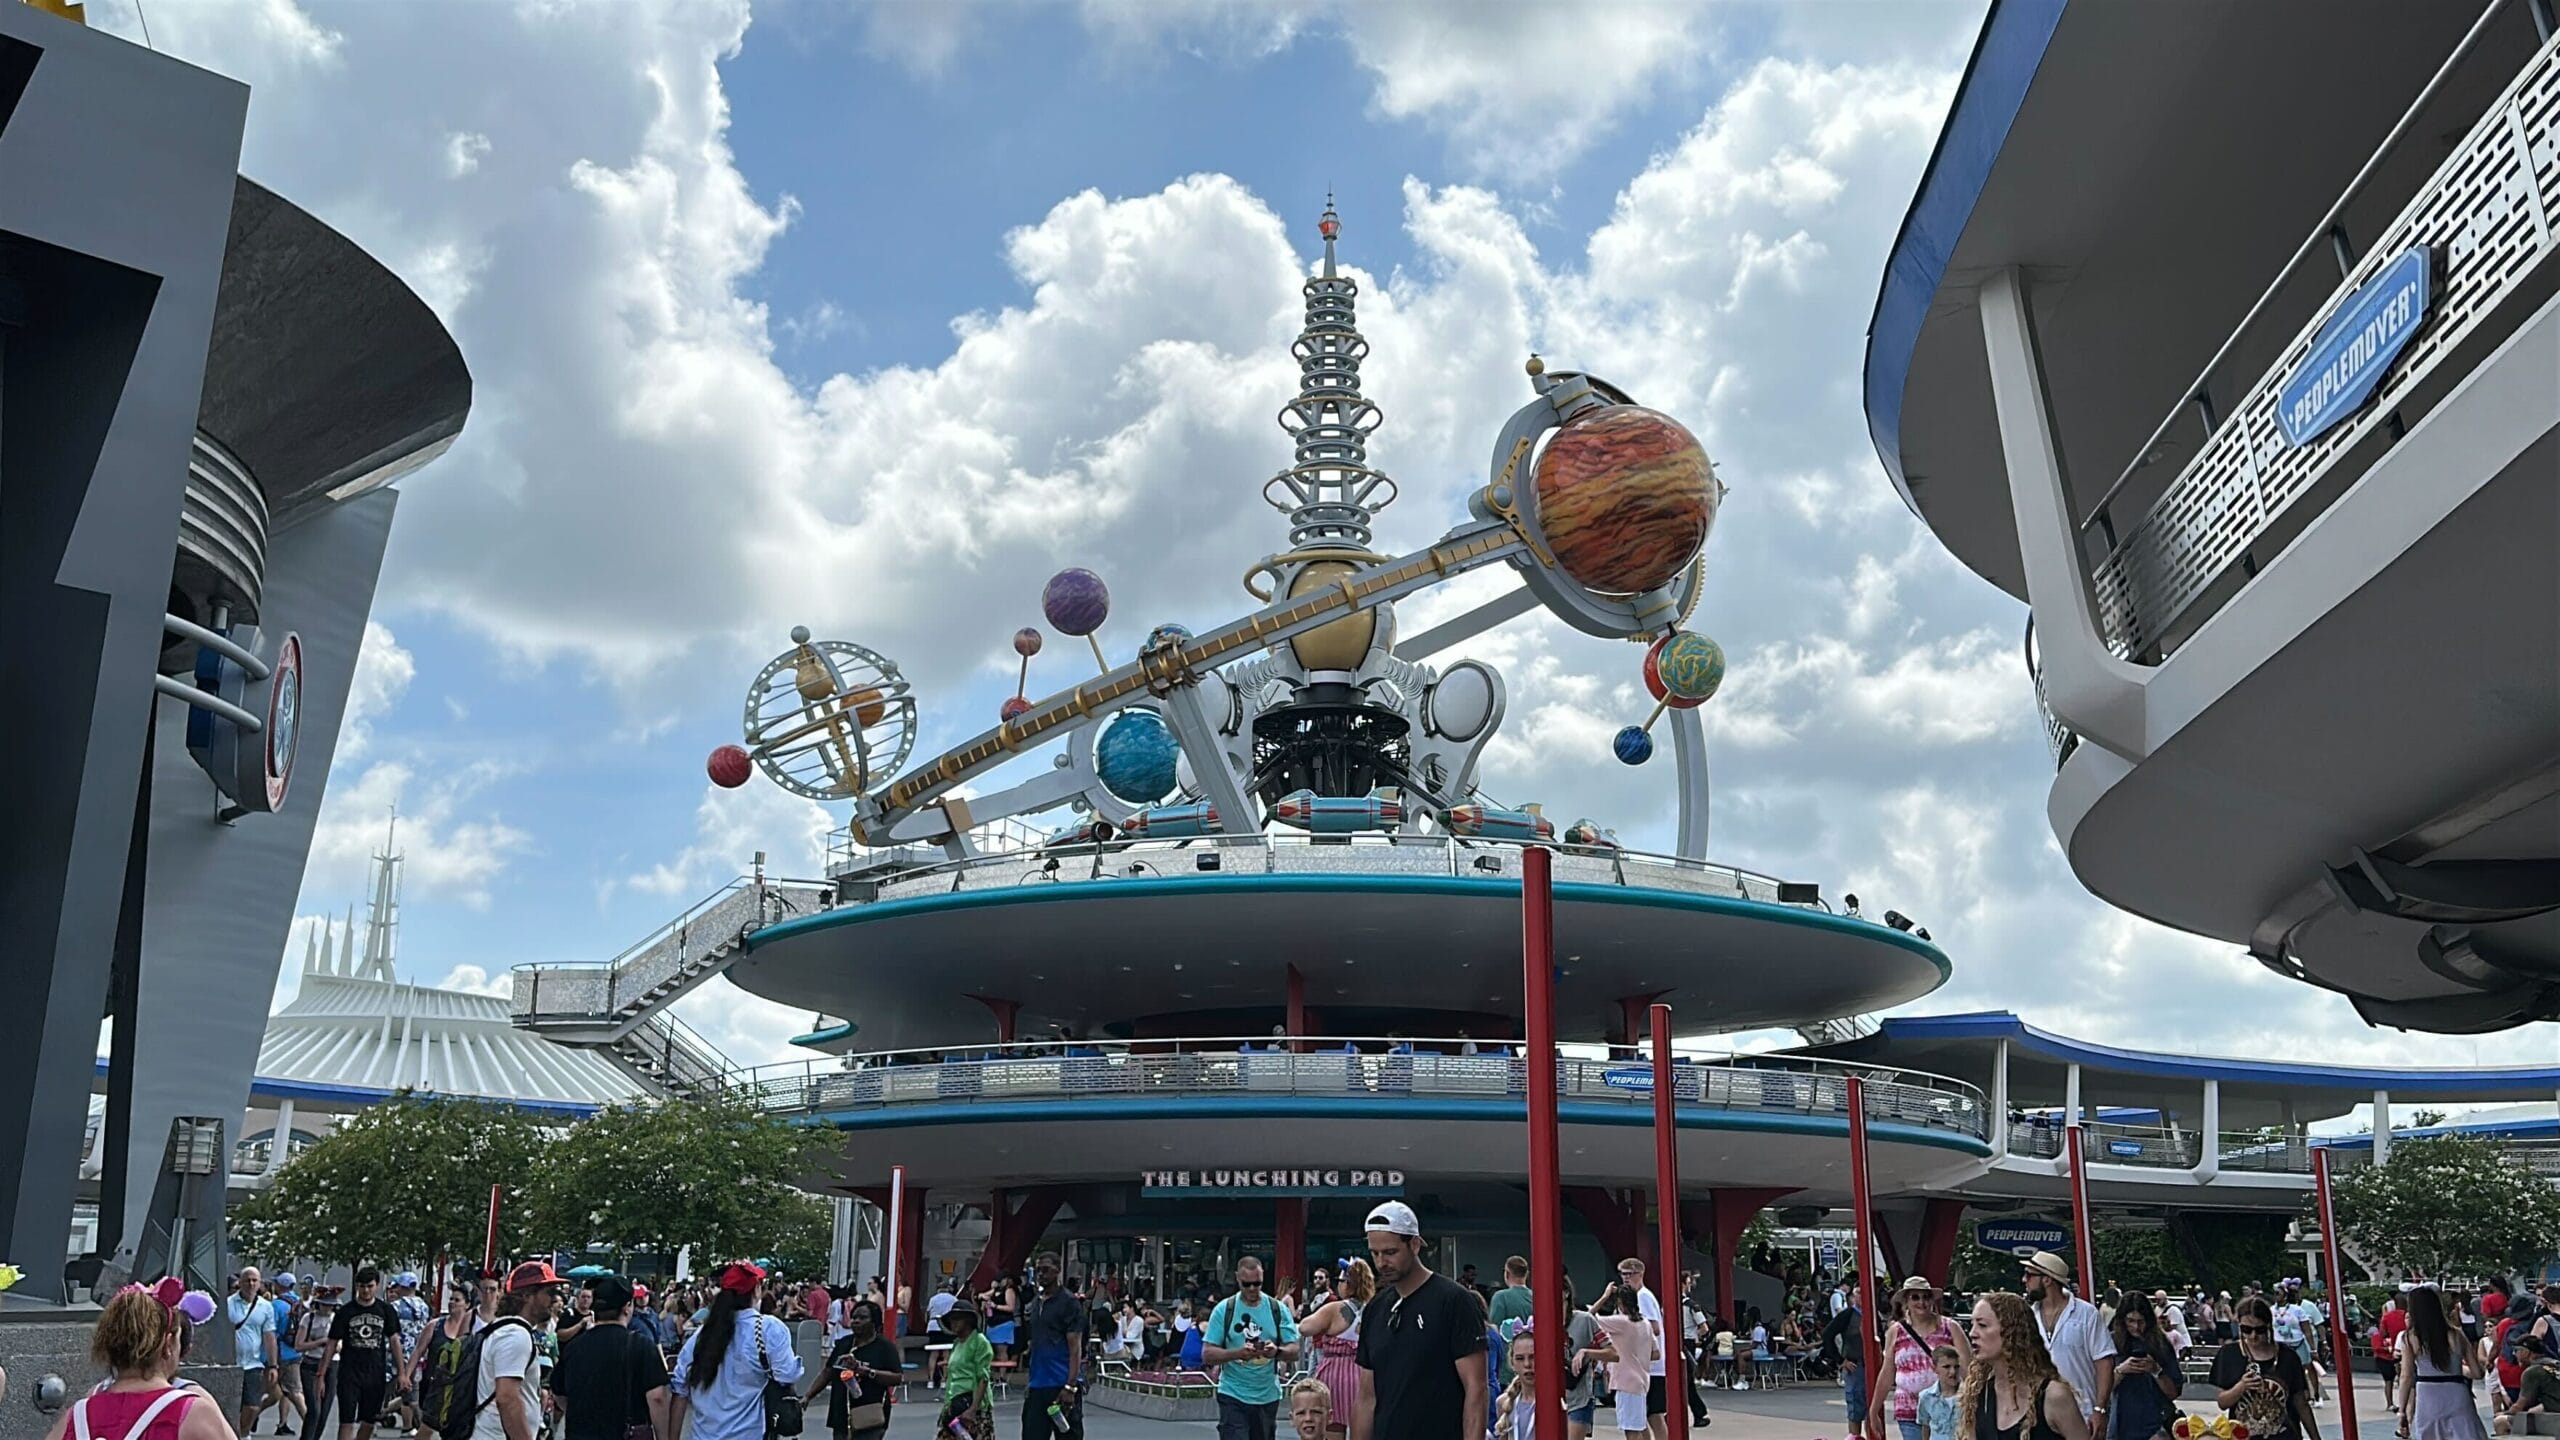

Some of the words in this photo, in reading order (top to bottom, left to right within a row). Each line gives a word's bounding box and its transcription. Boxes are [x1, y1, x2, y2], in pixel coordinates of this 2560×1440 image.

[2294, 288, 2410, 434] PEOPLEMOVER
[1610, 1076, 1654, 1085] PEOPLEMO
[1141, 1170, 1190, 1187] THE
[1200, 1170, 1339, 1187] LUNCHING
[1350, 1170, 1405, 1187] PAD
[1986, 1229, 2062, 1241] PEOPLEMOVER
